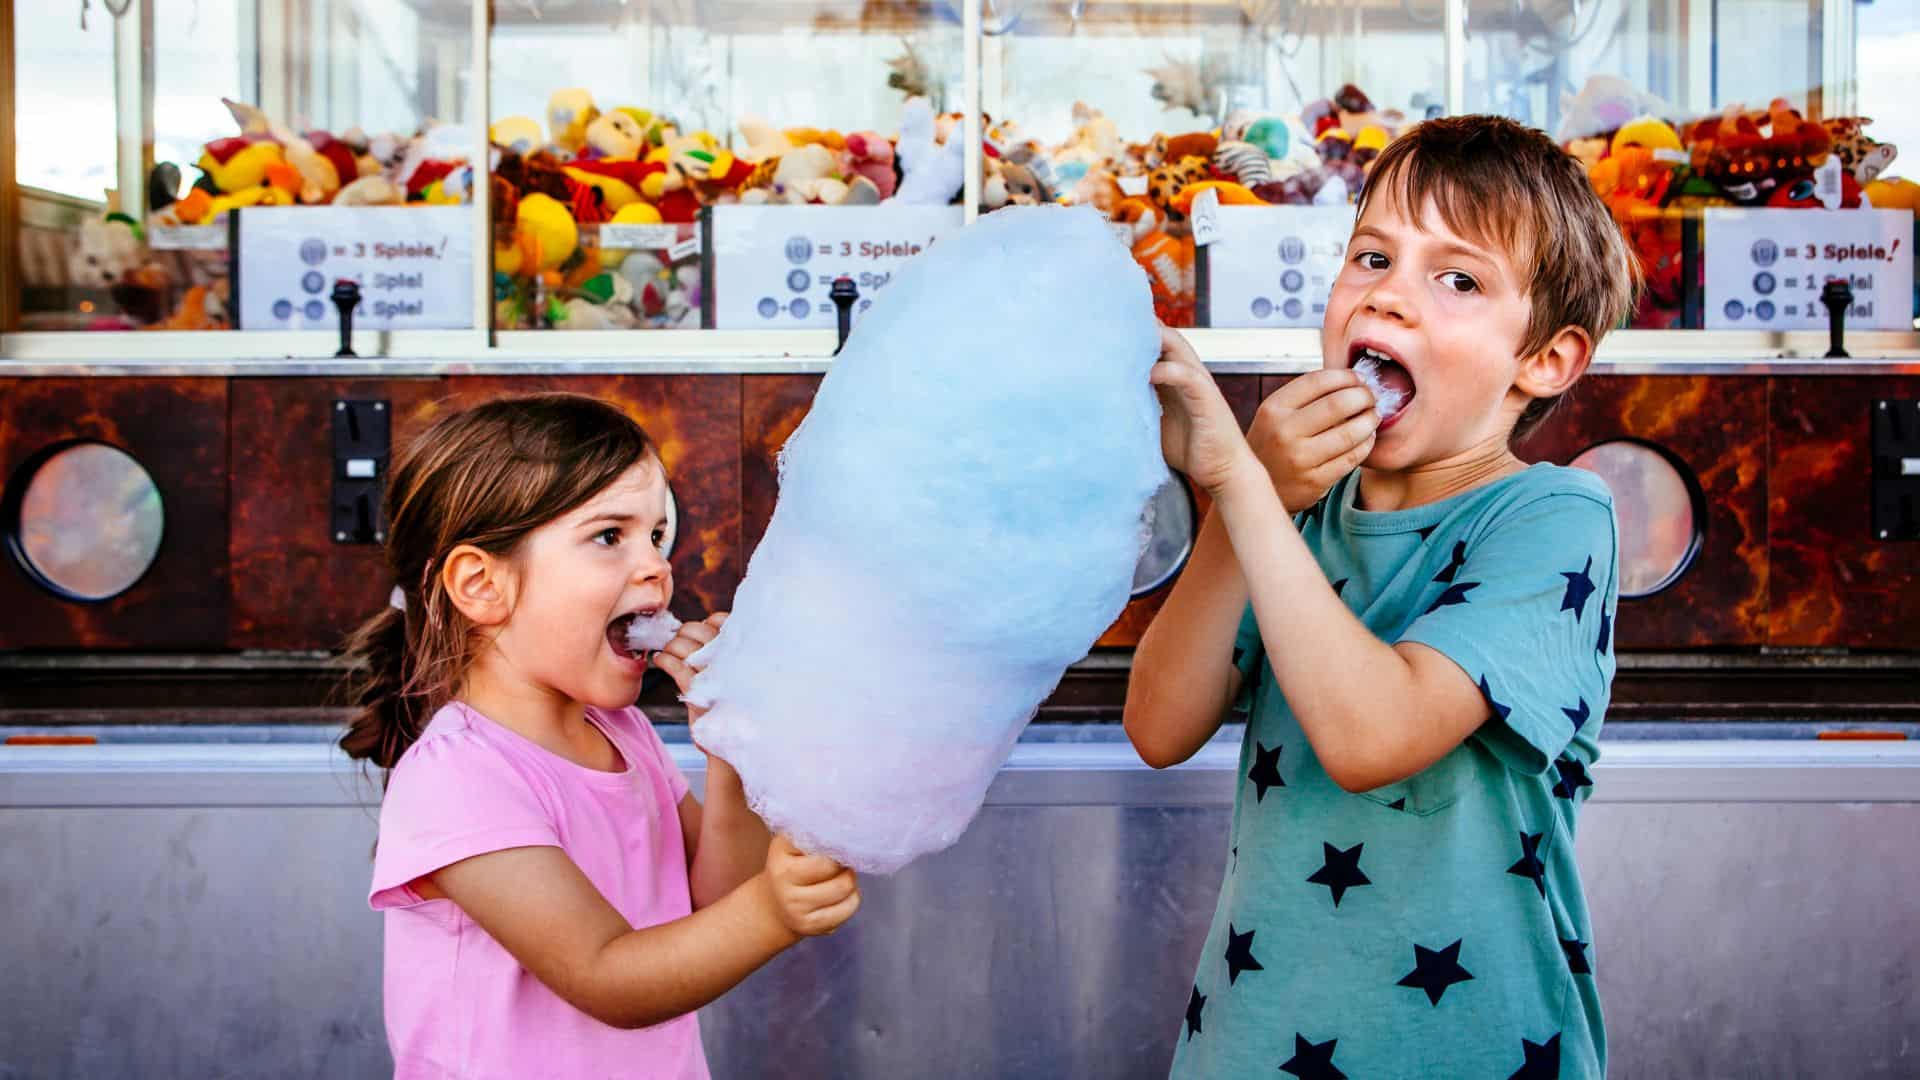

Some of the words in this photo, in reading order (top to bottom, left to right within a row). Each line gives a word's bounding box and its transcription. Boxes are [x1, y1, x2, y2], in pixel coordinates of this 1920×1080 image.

[354, 242, 365, 257] 3
[840, 241, 851, 256] 3
[1806, 244, 1816, 259] 3
[1824, 238, 1900, 262] Spiele!
[374, 272, 422, 291] Spiel
[1806, 274, 1816, 290] 1
[374, 300, 422, 319] Spiel
[1806, 302, 1816, 317] 1
